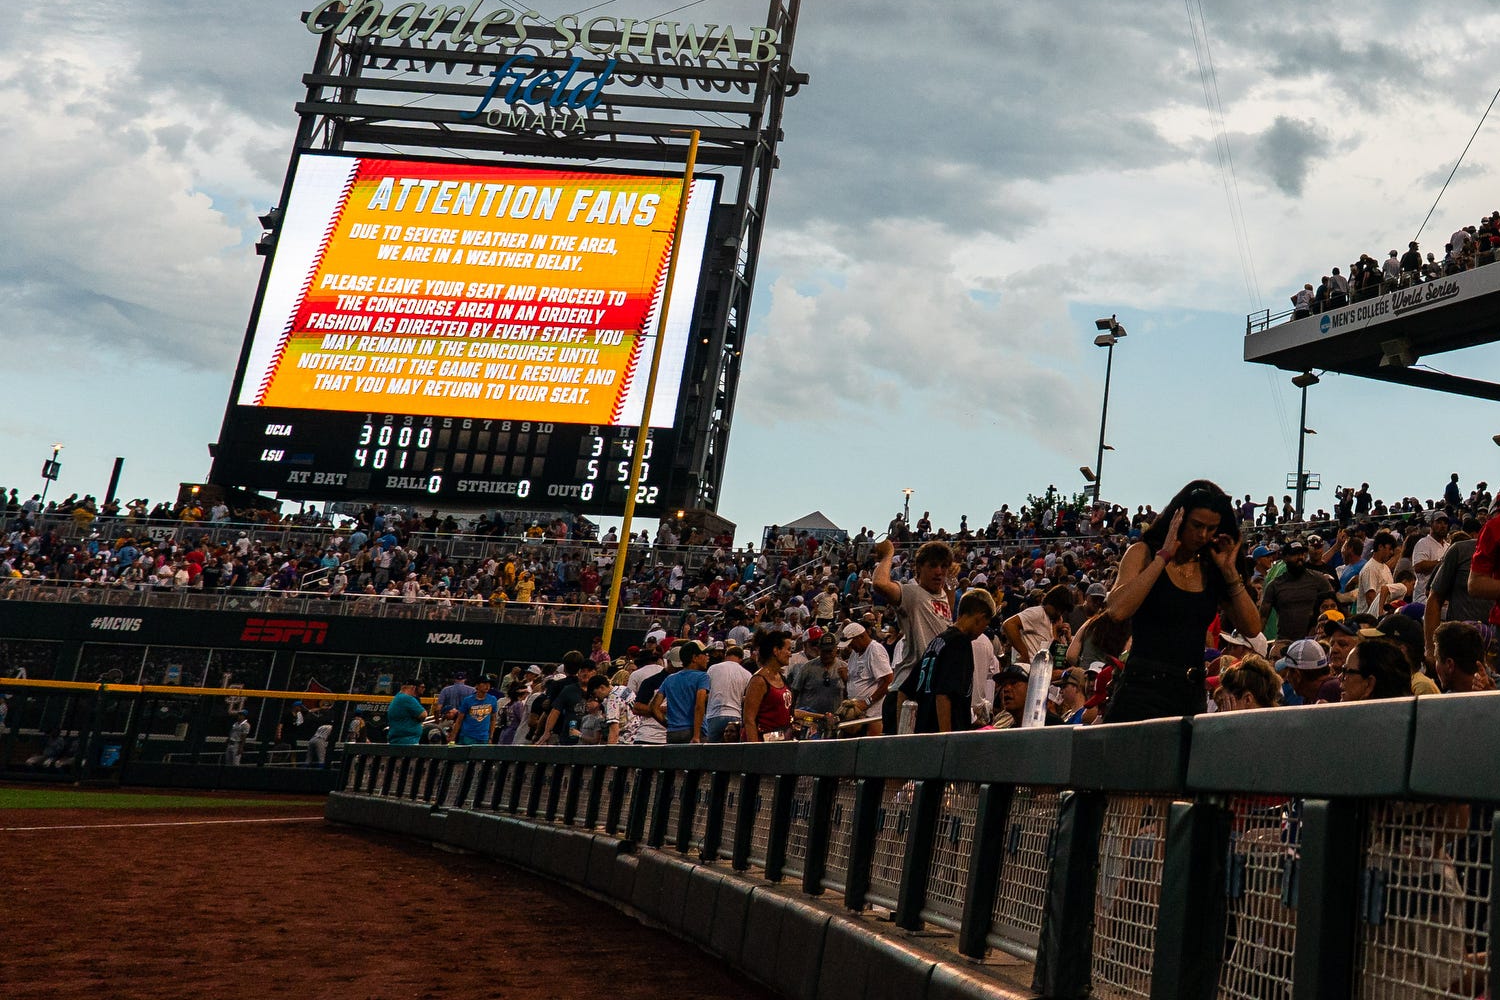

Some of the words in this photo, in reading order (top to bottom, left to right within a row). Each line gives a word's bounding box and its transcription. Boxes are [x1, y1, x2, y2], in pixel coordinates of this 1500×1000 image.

[551, 14, 778, 63] SCHWAB
[459, 54, 618, 119] field
[486, 109, 587, 132] OMAHA
[367, 177, 563, 221] ATTENTION
[567, 189, 661, 227] FANS
[349, 223, 381, 240] DUE
[382, 225, 403, 241] TO
[403, 226, 460, 245] SEVERE
[460, 230, 528, 249] WEATHER
[529, 234, 548, 250] IN
[550, 236, 577, 252] THE
[577, 238, 618, 256] AREA,
[377, 244, 402, 260] WE
[402, 246, 433, 263] ARE
[433, 248, 452, 264] IN
[452, 249, 464, 265] A
[466, 250, 534, 269] WEATHER
[535, 254, 583, 272] DELAY.
[320, 274, 377, 293] PLEASE
[377, 277, 423, 295] LEAVE
[424, 280, 465, 297] YOUR
[466, 282, 505, 300] SEAT
[504, 285, 536, 302] AND
[537, 286, 605, 306] PROCEED
[607, 290, 627, 307] TO
[1331, 309, 1356, 329] MEN'S
[1356, 300, 1390, 322] COLLEGE
[1392, 287, 1423, 311] World
[1425, 280, 1459, 301] Series
[336, 294, 366, 311] THE
[365, 296, 456, 316] CONCOURSE
[455, 301, 495, 319] AREA
[496, 304, 514, 320] IN
[514, 305, 537, 321] AN
[538, 306, 606, 325] ORDERLY
[306, 313, 373, 332] FASHION
[373, 316, 396, 333] AS
[396, 318, 468, 337] DIRECTED
[469, 322, 493, 338] BY
[492, 324, 540, 342] EVENT
[540, 326, 588, 344] STAFF.
[593, 330, 625, 346] YOU
[320, 334, 358, 351] MAY
[357, 336, 418, 354] REMAIN
[418, 339, 437, 355] IN
[437, 340, 467, 358] THE
[467, 341, 559, 362] CONCOURSE
[558, 347, 601, 365] UNTIL
[297, 353, 367, 372] NOTIFIED
[368, 356, 407, 374] THAT
[408, 358, 438, 376] THE
[438, 360, 483, 379] GAME
[483, 363, 519, 381] WILL
[520, 365, 584, 384] RESUME
[583, 369, 616, 386] AND
[313, 374, 353, 392] THAT
[354, 376, 386, 393] YOU
[386, 378, 424, 396] MAY
[423, 380, 483, 399] RETURN
[484, 383, 506, 400] TO
[507, 385, 549, 403] YOUR
[549, 387, 590, 405] SEAT.
[265, 424, 293, 436] UCLA
[359, 425, 373, 445] 3
[378, 426, 392, 446] 0
[398, 427, 412, 448] 0
[418, 428, 432, 448] 0
[592, 436, 604, 457] 3
[622, 439, 634, 457] 4
[365, 413, 374, 424] 1
[384, 414, 394, 425] 2
[403, 416, 413, 426] 3
[423, 416, 433, 427] 4
[443, 418, 453, 429] 5
[462, 419, 472, 429] 6
[483, 420, 492, 431] 7
[502, 421, 511, 432] 8
[521, 422, 531, 432] 9
[537, 423, 554, 434] 10
[588, 426, 599, 436] R
[619, 427, 631, 437] H
[260, 449, 285, 462] LSU
[355, 449, 368, 467] 4
[373, 449, 388, 469] 0
[399, 451, 408, 469] 1
[587, 460, 598, 480] 5
[617, 461, 629, 481] 5
[287, 470, 311, 483] AT
[312, 472, 347, 486] BAT
[385, 475, 428, 490] BALL
[427, 475, 442, 493] 0
[456, 480, 517, 495] STRIKE
[517, 479, 531, 498] 0
[547, 483, 581, 498] OUT
[580, 483, 594, 501] 0
[90, 616, 142, 632] #MCWS
[240, 618, 329, 644] ESPN
[426, 632, 484, 646] NCAA.com
